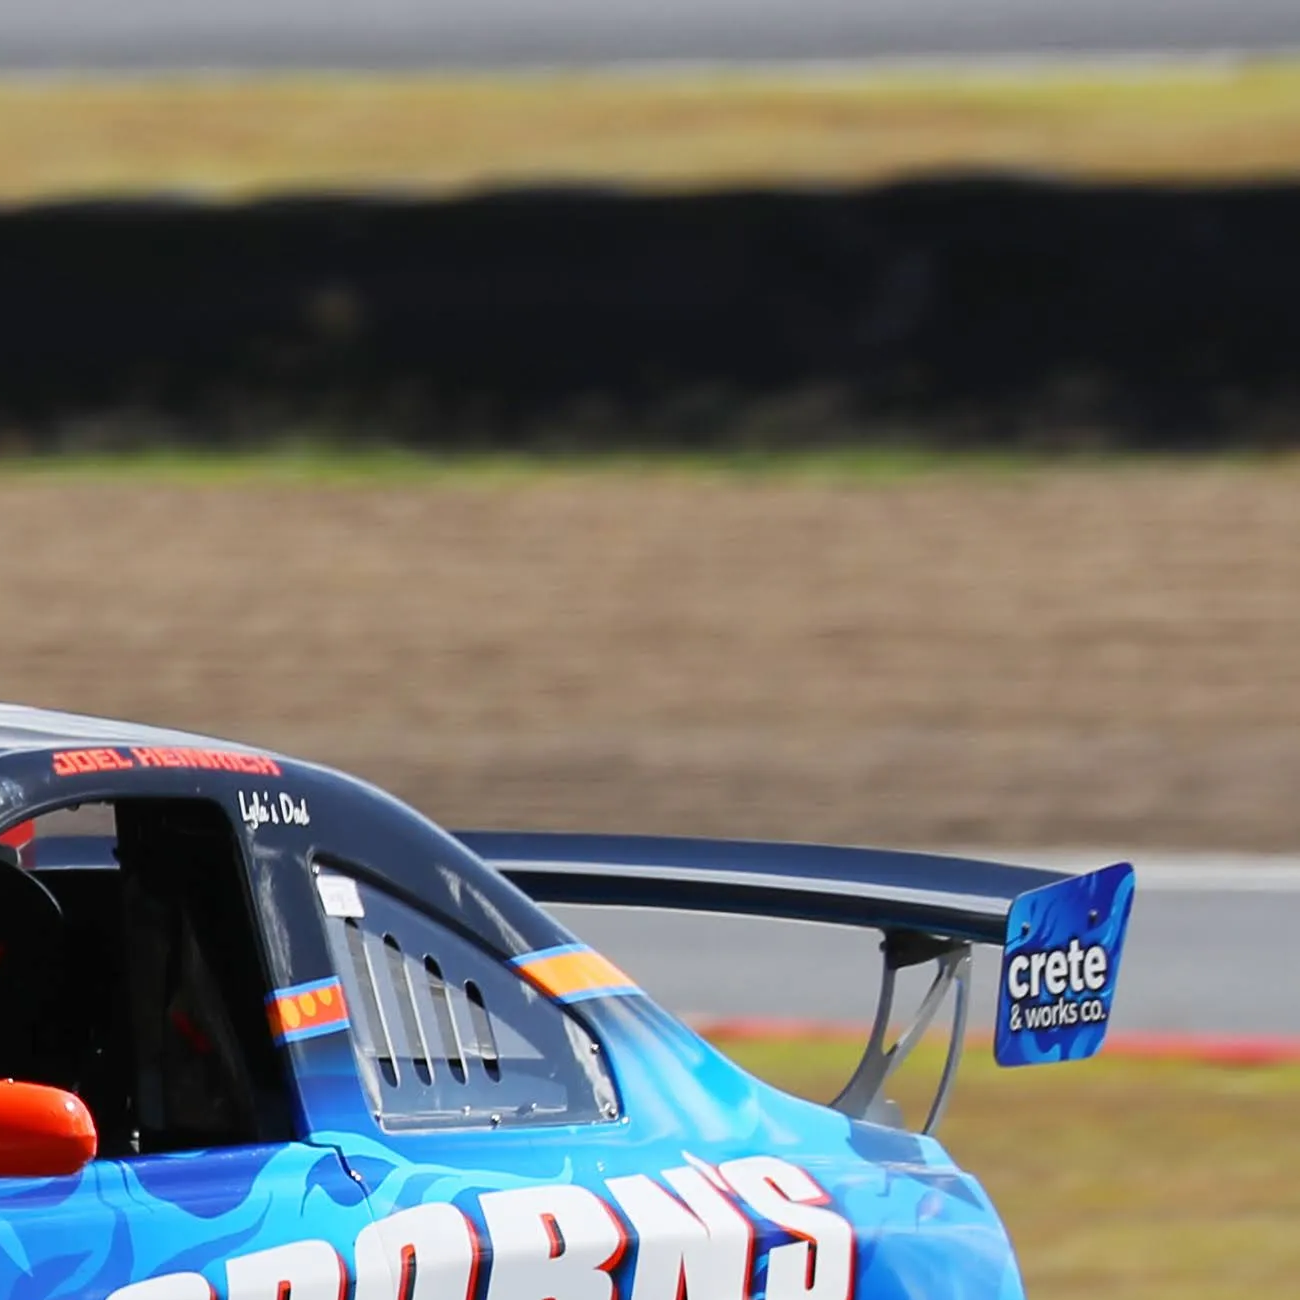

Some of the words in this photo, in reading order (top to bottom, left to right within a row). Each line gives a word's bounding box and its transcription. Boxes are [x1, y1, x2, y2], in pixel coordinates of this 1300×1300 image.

[53, 748, 133, 776] JOEL
[131, 747, 283, 777] HEINRICH
[279, 791, 310, 826] Dad
[1008, 939, 1107, 999] crete
[1009, 1005, 1022, 1031] &
[1025, 997, 1078, 1029] works
[1081, 1000, 1106, 1021] co.
